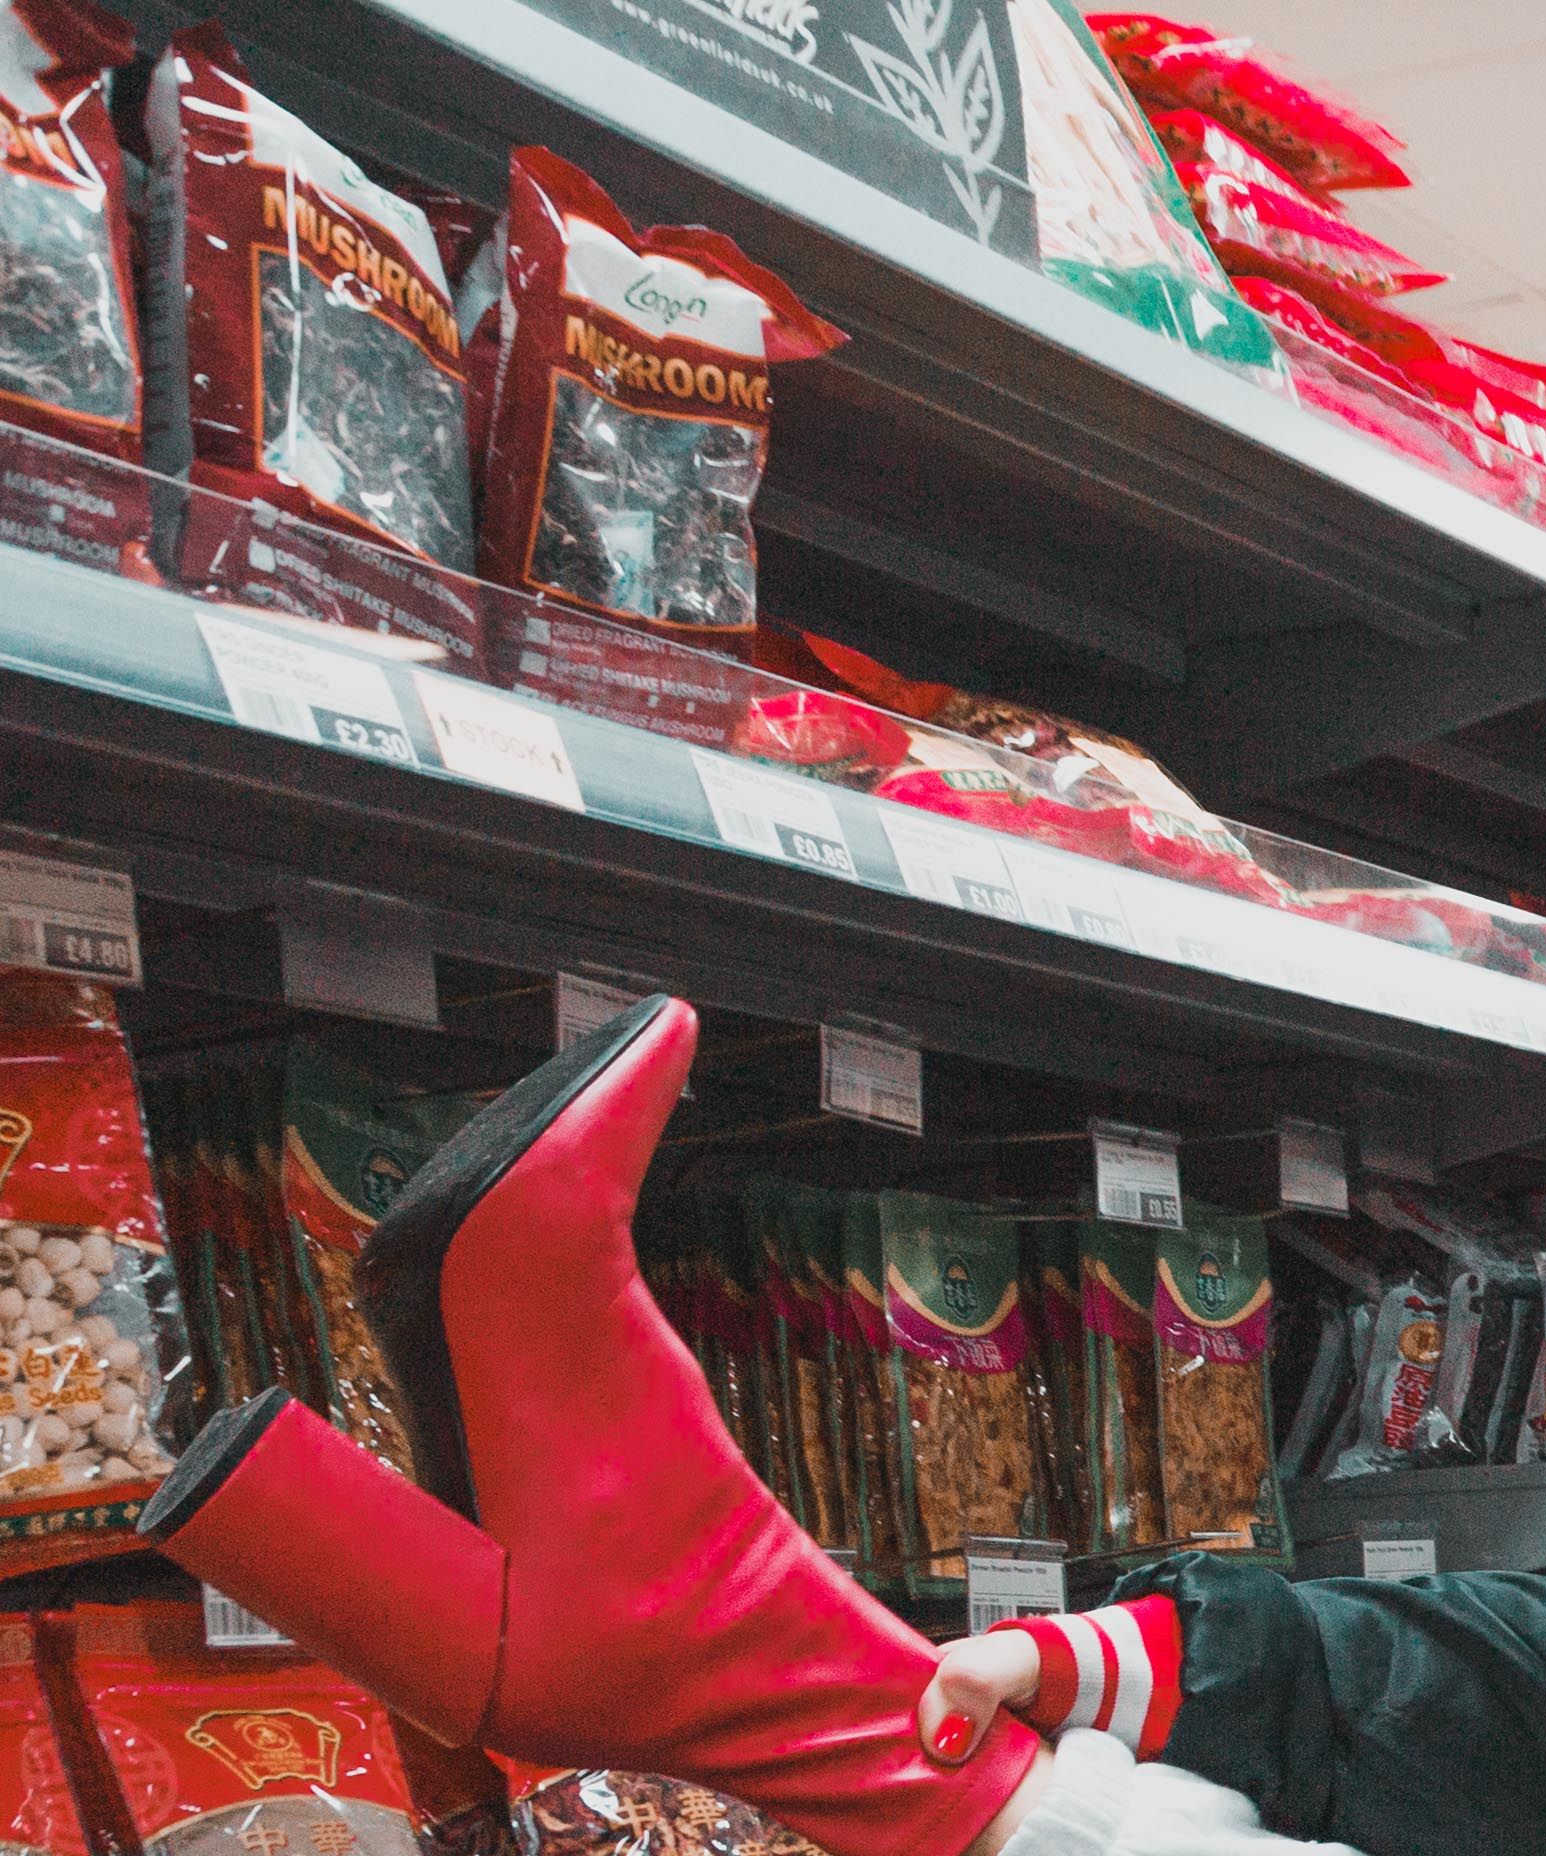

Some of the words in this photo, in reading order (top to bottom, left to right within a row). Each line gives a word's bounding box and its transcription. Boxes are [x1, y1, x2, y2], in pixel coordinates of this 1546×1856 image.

[333, 718, 411, 762] £2.30
[457, 718, 547, 768] STOCK
[794, 833, 851, 873] £0.85
[29, 1383, 105, 1409] Seeds
